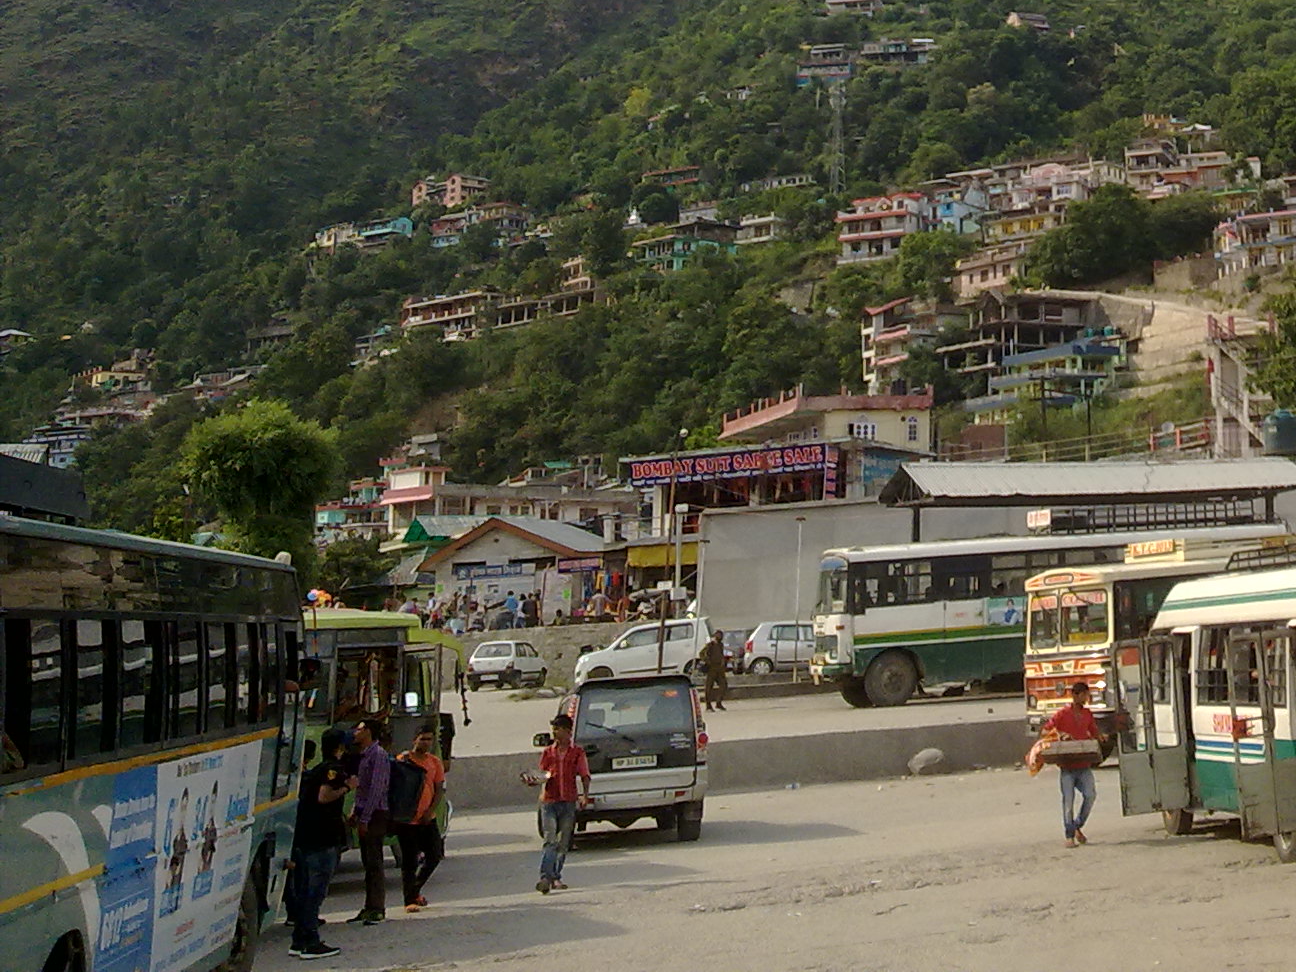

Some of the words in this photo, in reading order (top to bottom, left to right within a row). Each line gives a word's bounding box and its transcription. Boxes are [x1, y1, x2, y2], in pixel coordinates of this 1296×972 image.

[631, 458, 694, 479] BOMBAY
[695, 455, 731, 474] SUIT
[733, 450, 782, 470] SARE
[784, 446, 823, 465] SALE
